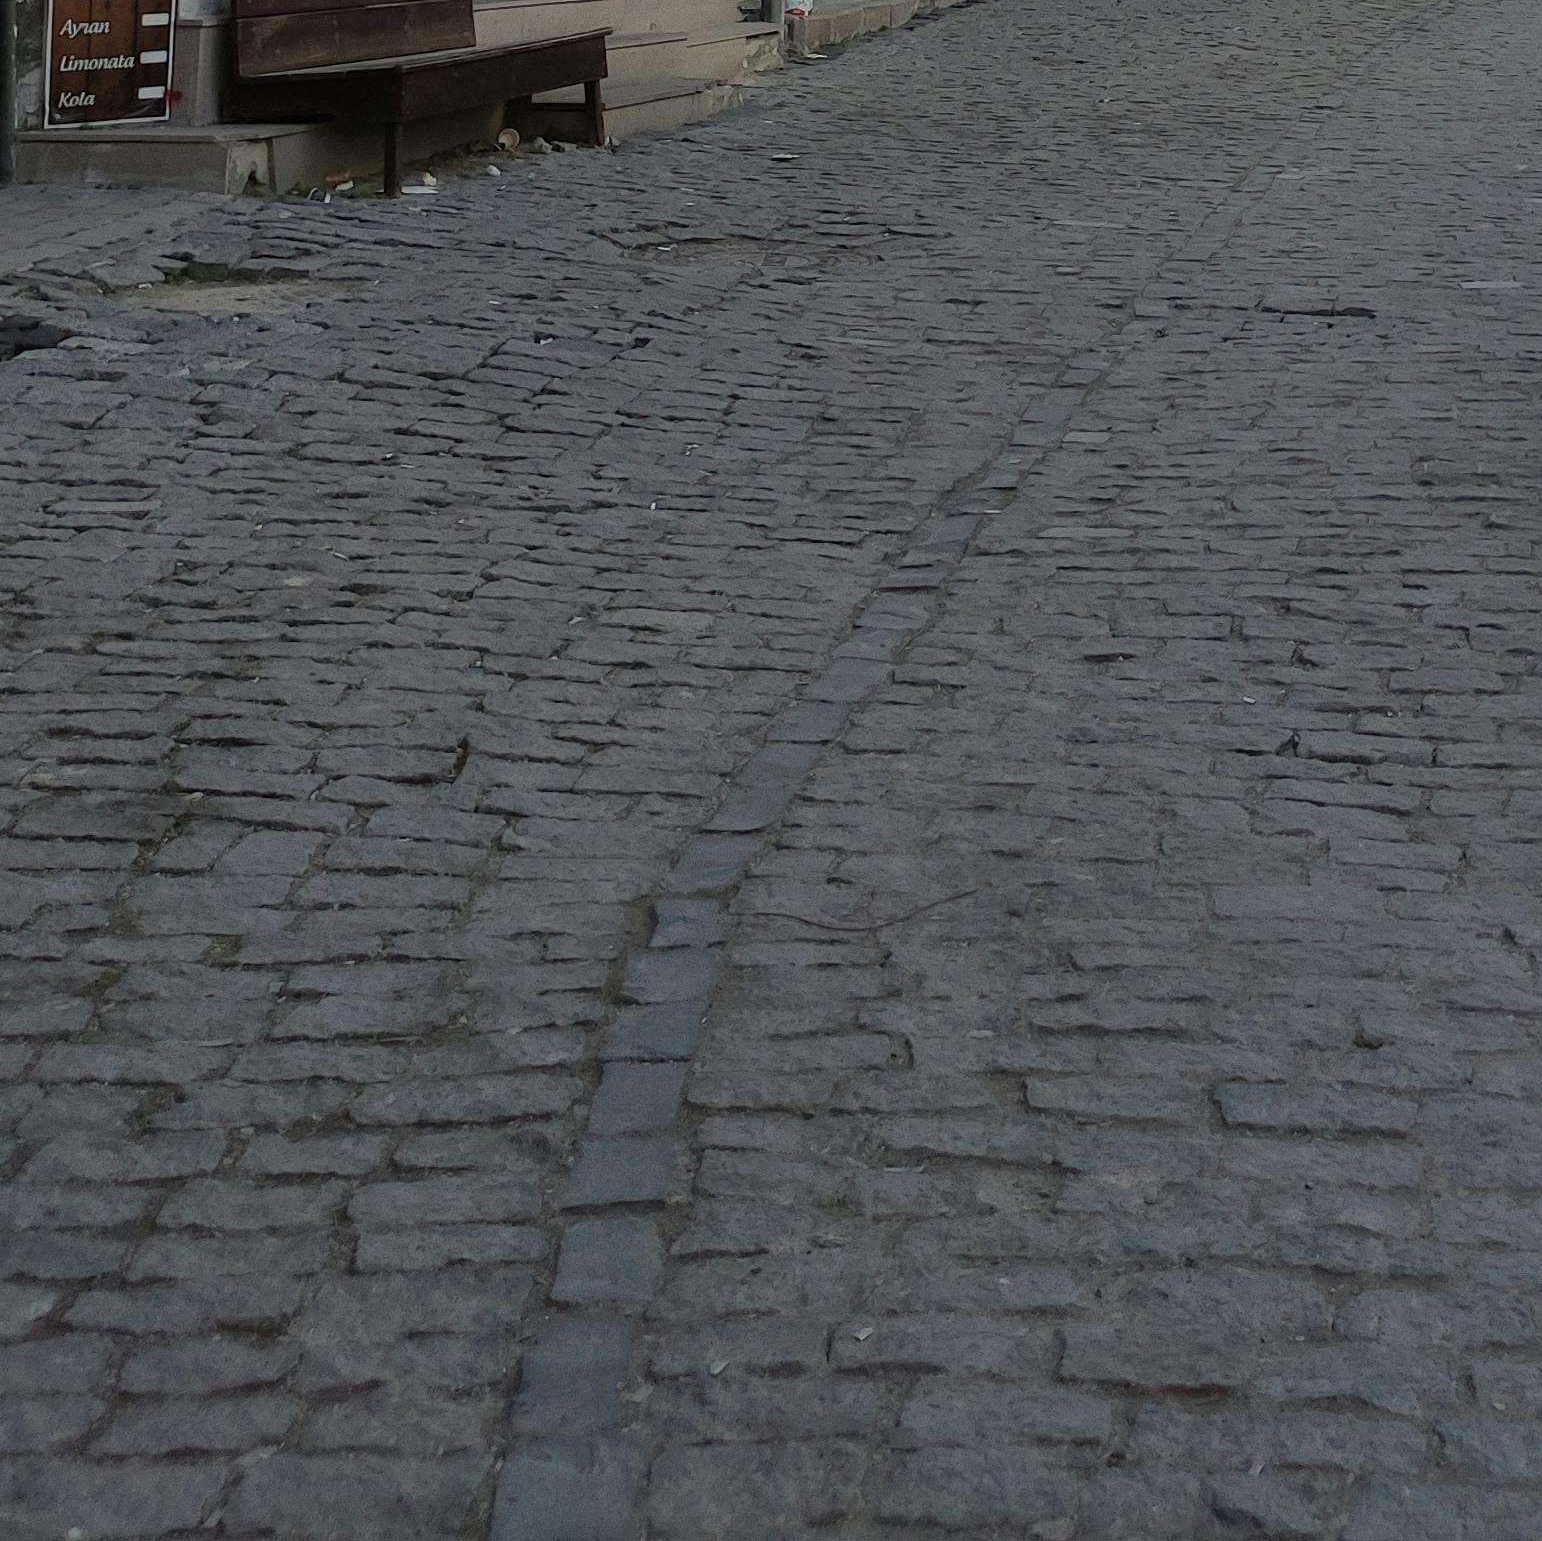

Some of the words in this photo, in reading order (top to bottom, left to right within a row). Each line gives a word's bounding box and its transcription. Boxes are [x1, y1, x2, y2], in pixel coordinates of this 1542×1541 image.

[60, 19, 110, 40] Ayran
[60, 55, 135, 72] Limonata
[58, 92, 96, 109] Kola
